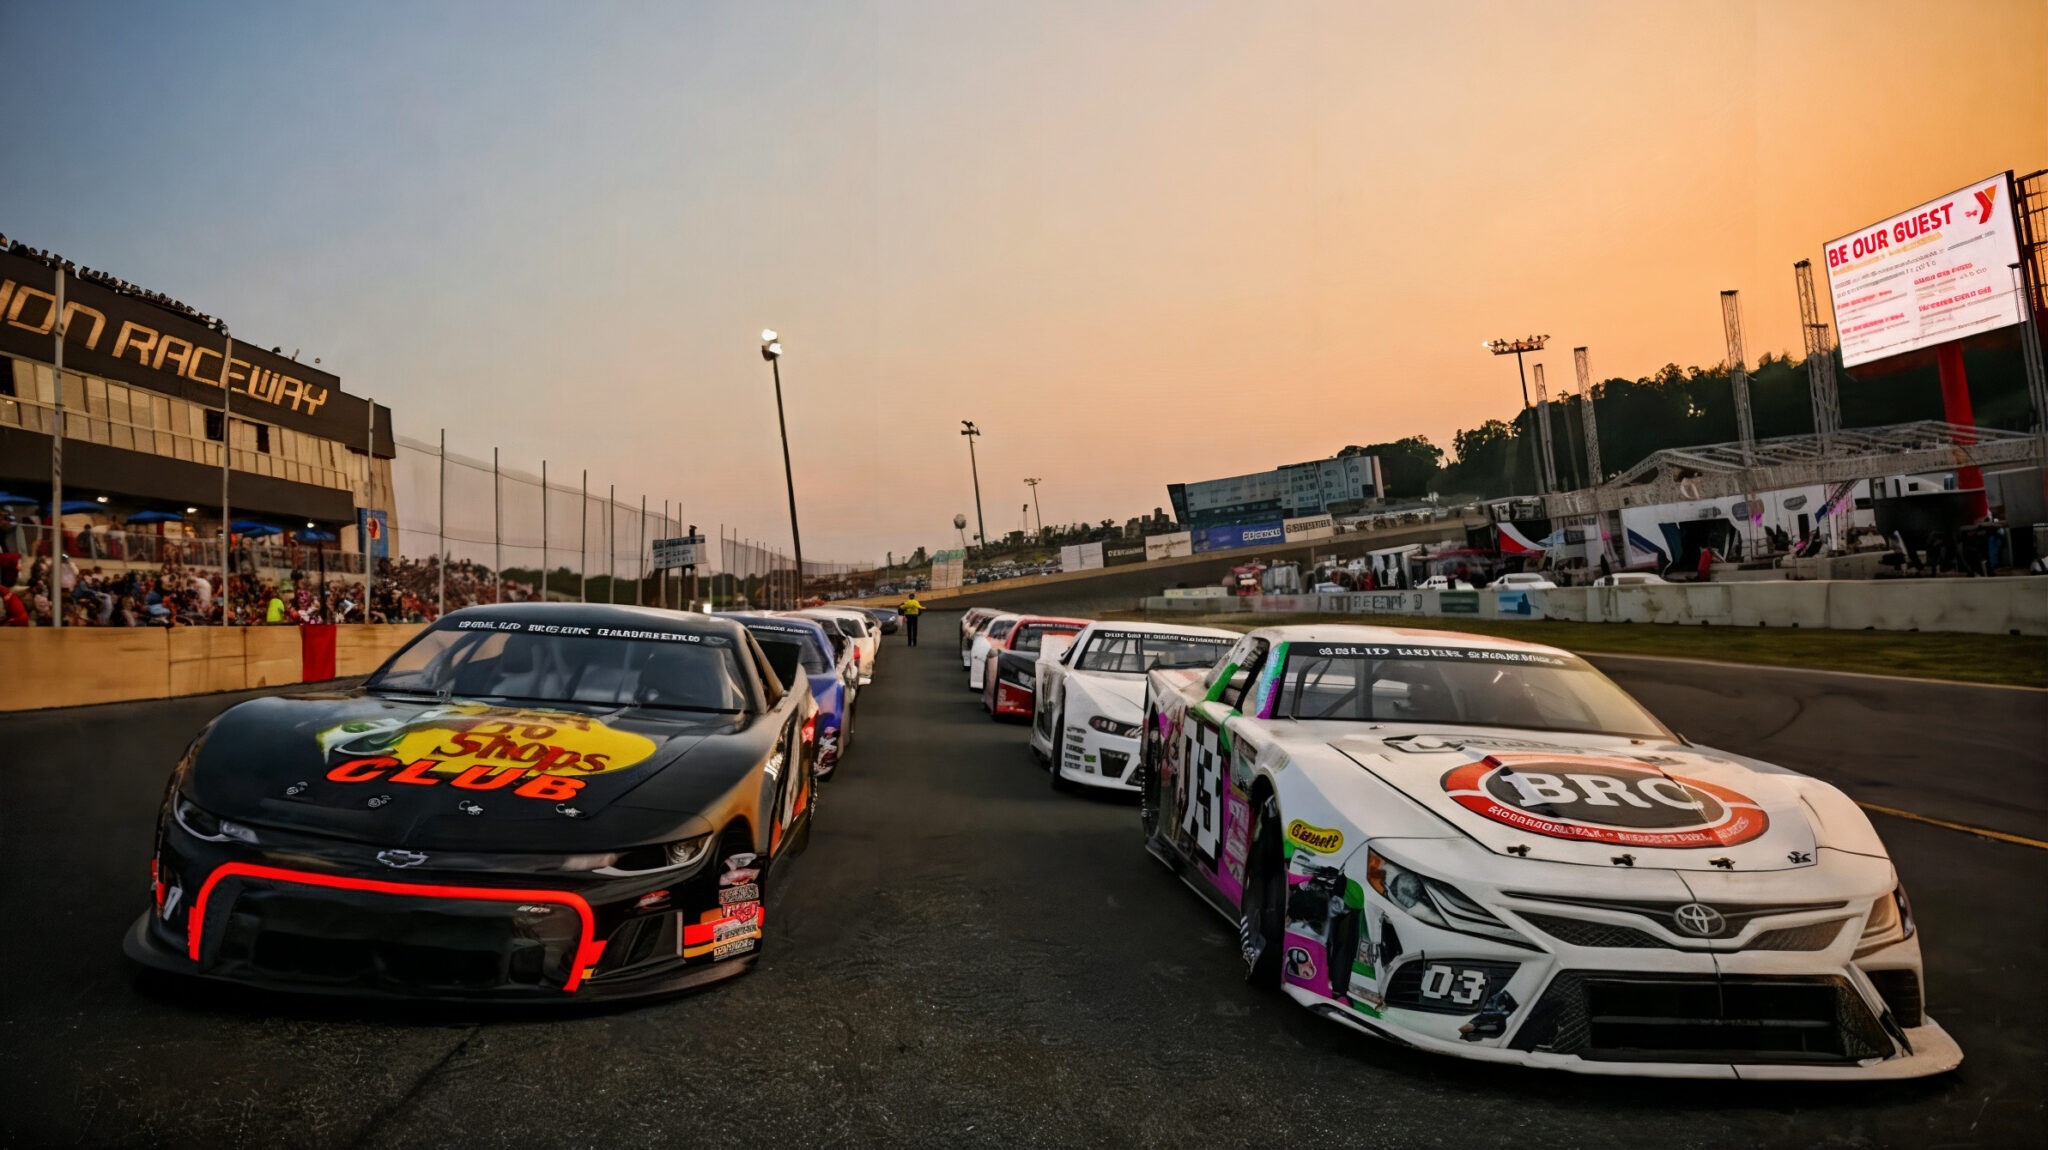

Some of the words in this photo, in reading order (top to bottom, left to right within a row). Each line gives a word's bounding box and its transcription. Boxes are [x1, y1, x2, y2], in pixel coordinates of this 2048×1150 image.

[1828, 244, 1849, 268] BE
[1852, 229, 1889, 259] OUR
[1893, 202, 1954, 243] GUEST
[112, 320, 328, 416] RACEWAY
[440, 733, 611, 772] Shops
[326, 757, 587, 801] CLUB
[1500, 771, 1704, 811] BRC
[1421, 964, 1486, 1004] 03
